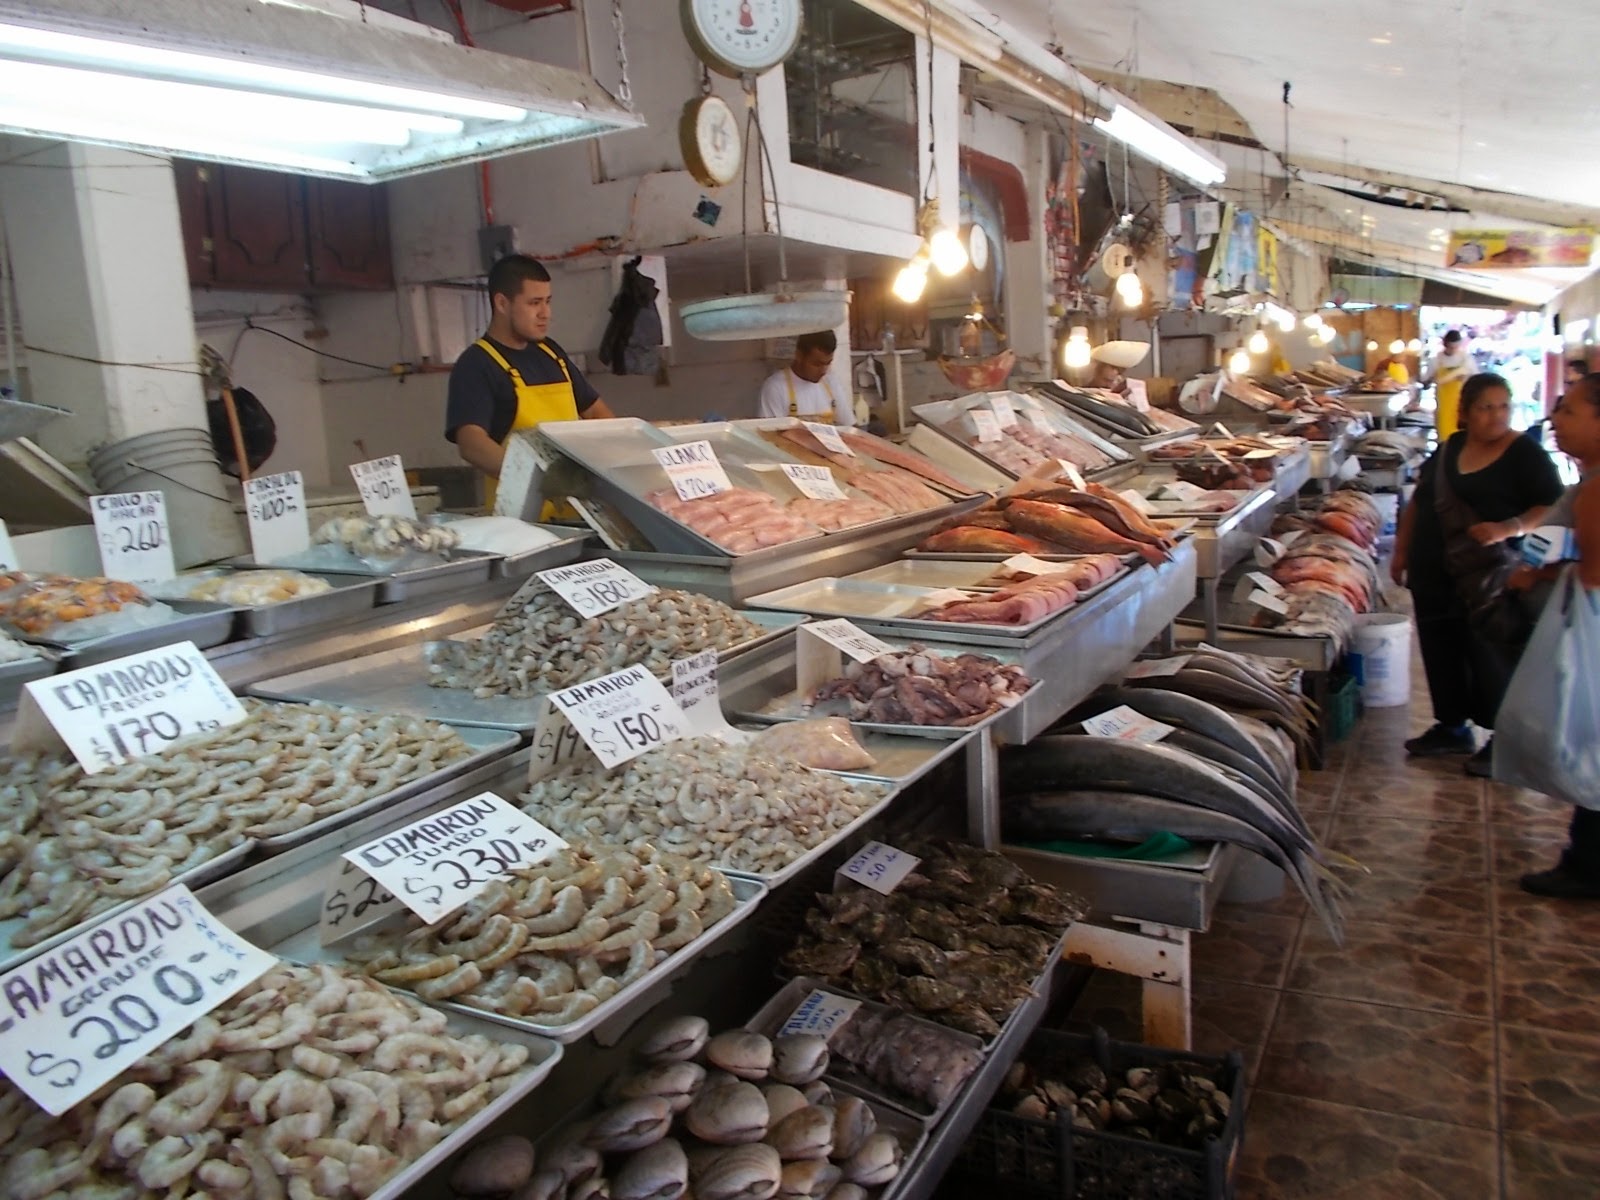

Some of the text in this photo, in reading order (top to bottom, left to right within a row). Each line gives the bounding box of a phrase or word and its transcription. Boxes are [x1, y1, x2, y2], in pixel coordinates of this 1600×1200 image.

[543, 561, 615, 585] CAMARON
[54, 654, 192, 711] CAMARON
[557, 668, 645, 708] CAMARON
[359, 799, 498, 868] CAMARON
[406, 827, 487, 866] JUMBO
[0, 902, 182, 1033] AMARON
[60, 944, 168, 1018] GRANDE
